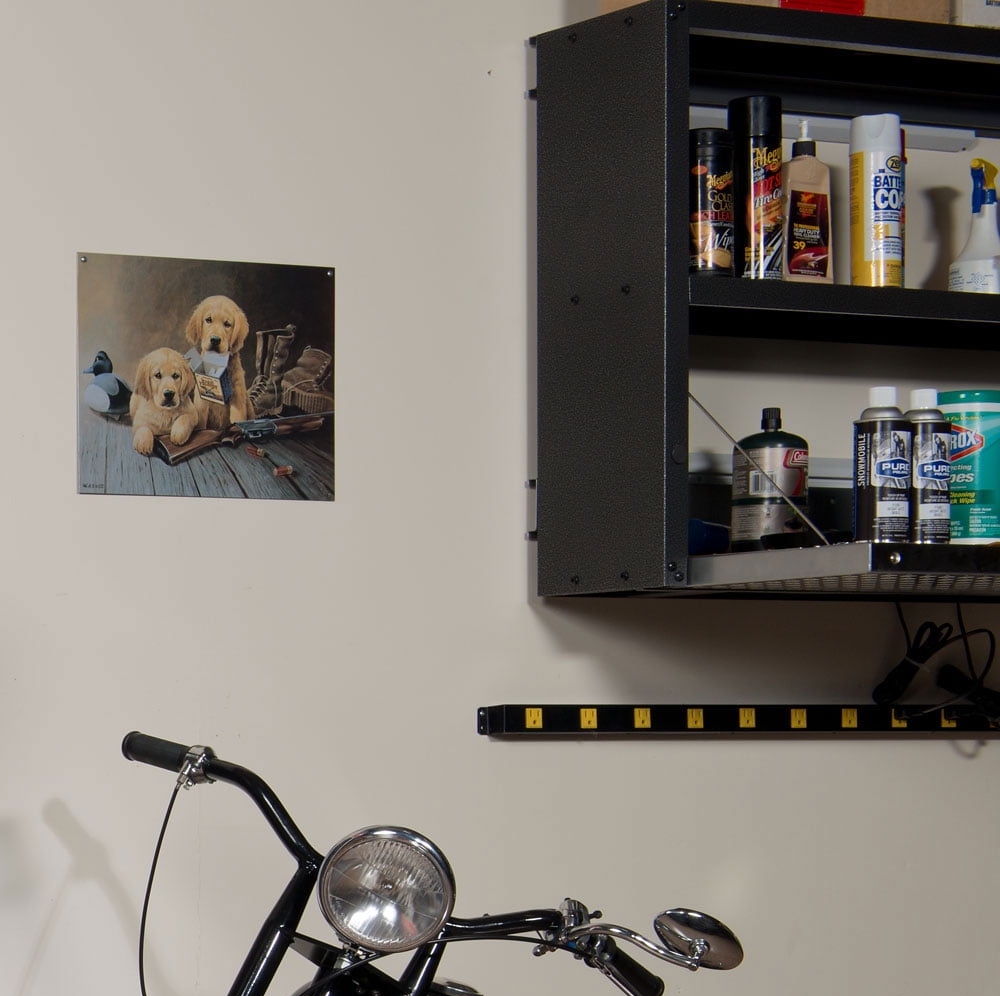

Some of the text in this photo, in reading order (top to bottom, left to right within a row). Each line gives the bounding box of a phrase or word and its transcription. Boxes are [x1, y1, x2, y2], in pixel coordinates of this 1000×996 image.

[875, 189, 901, 209] CO
[793, 241, 806, 250] 39
[950, 431, 977, 450] ROX
[858, 433, 866, 489] SNOWMOBILE
